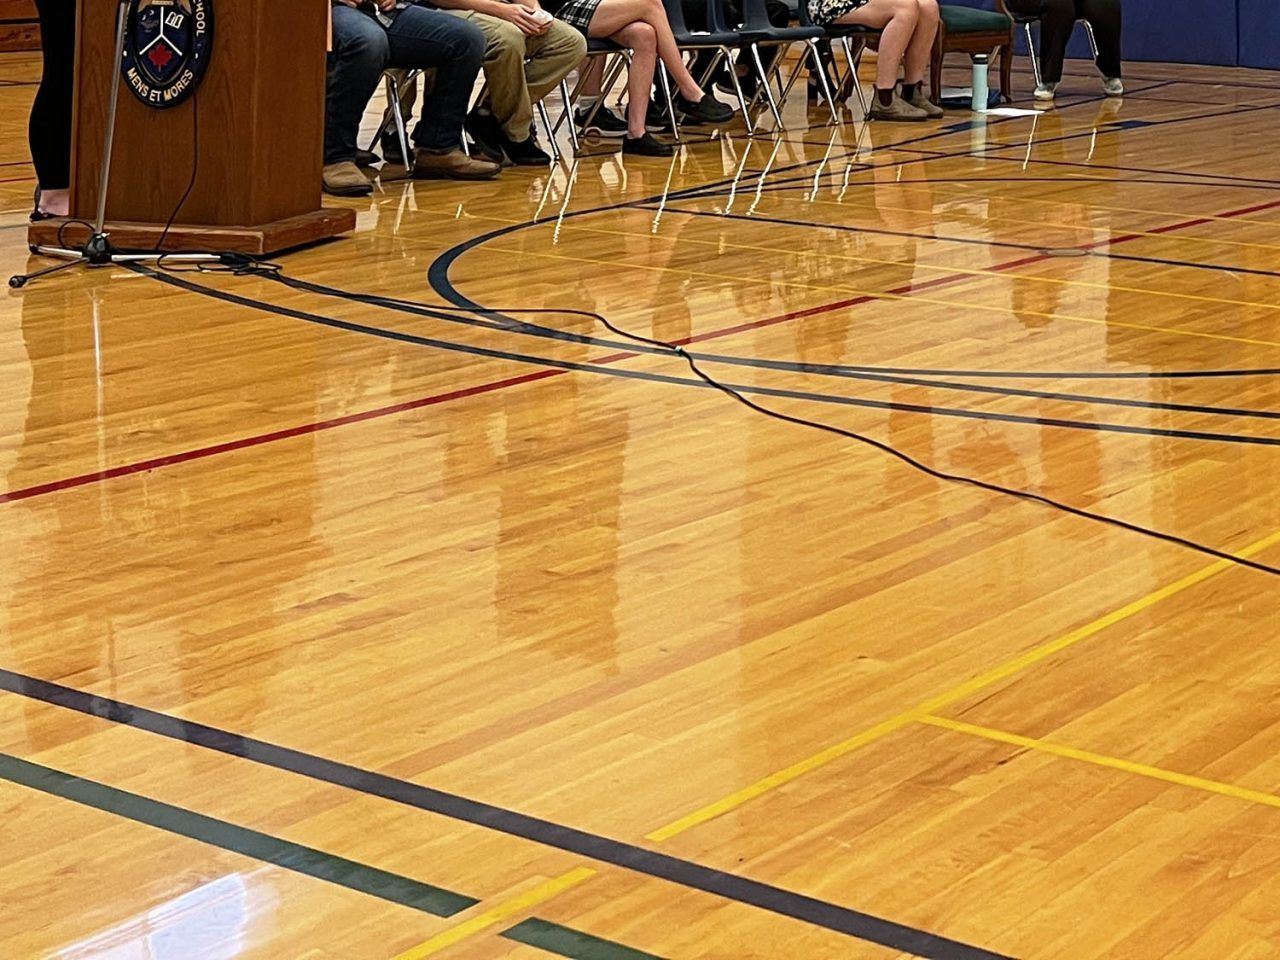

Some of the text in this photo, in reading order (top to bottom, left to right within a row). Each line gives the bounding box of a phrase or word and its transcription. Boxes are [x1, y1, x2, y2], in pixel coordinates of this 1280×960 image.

[127, 67, 194, 102] MENS ET MORES
